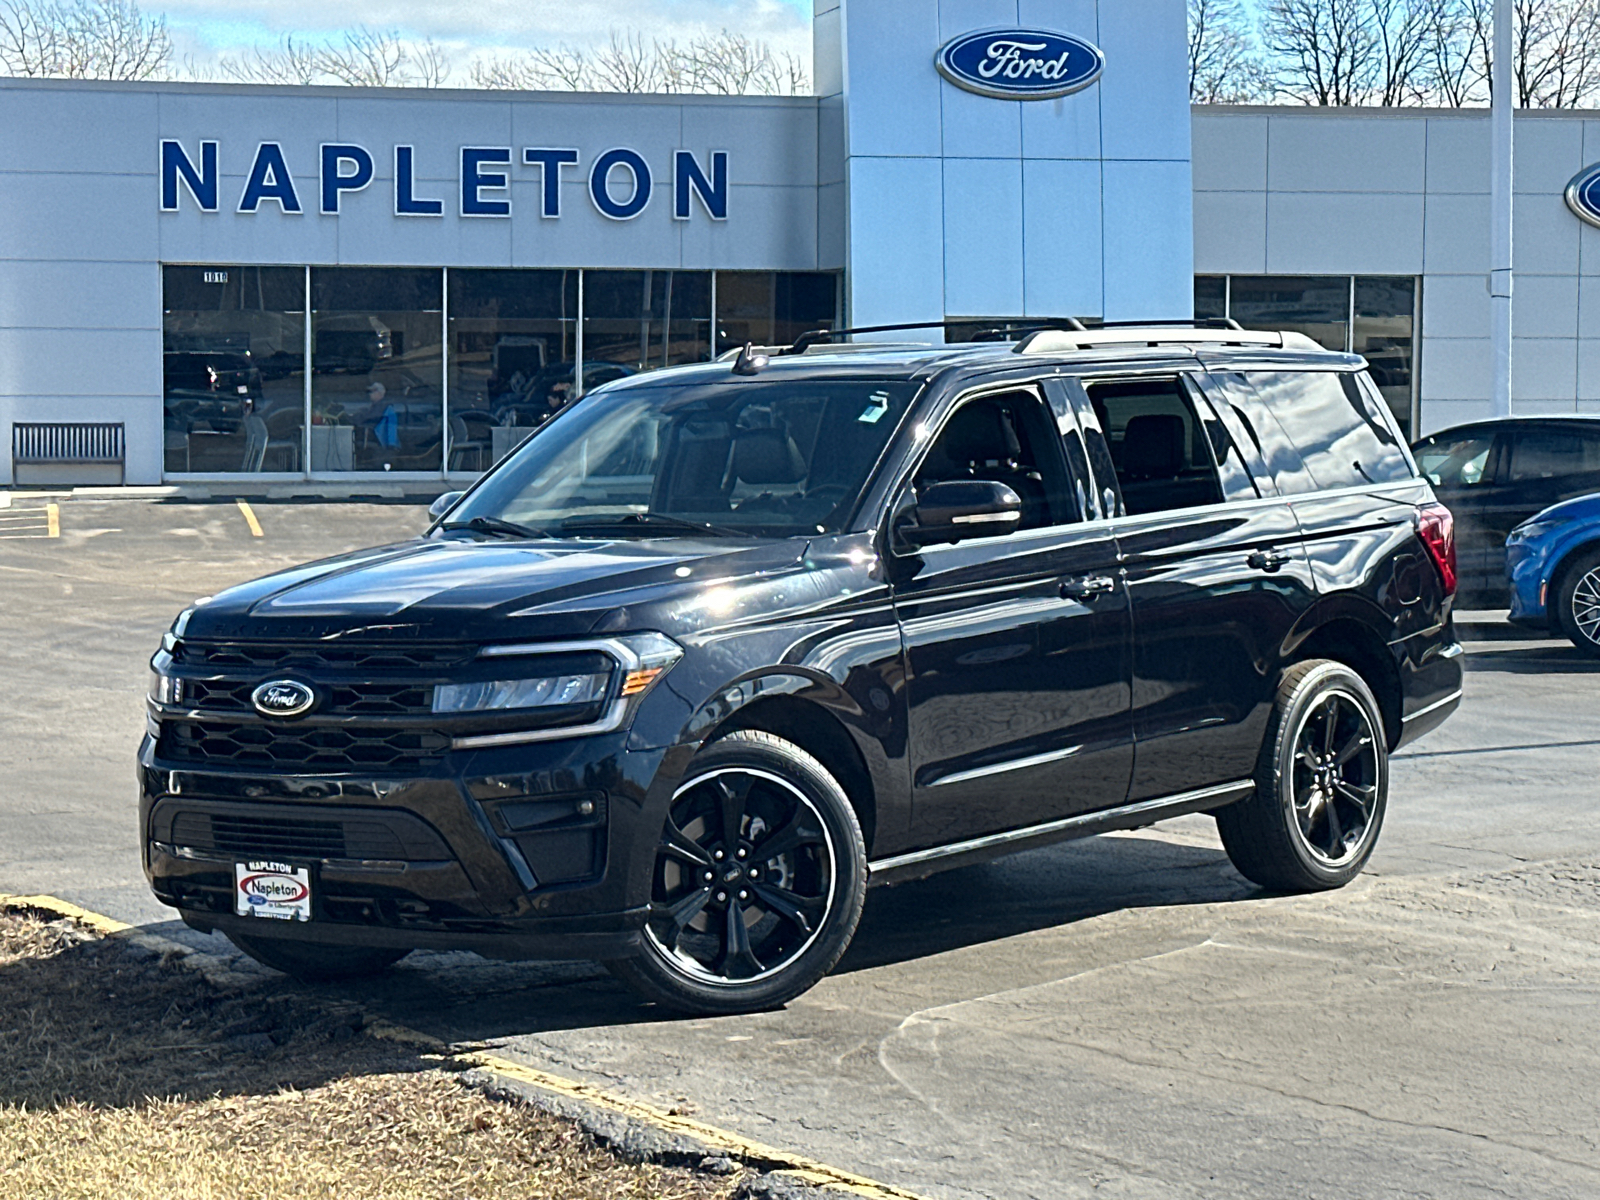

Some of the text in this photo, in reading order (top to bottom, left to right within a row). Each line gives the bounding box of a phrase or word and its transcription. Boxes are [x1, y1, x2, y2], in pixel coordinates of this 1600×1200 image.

[978, 40, 1070, 80] Ford
[158, 138, 730, 221] NAPLETON
[264, 686, 298, 706] Ford
[248, 861, 292, 874] NAPLETON
[251, 880, 298, 897] Napleton
